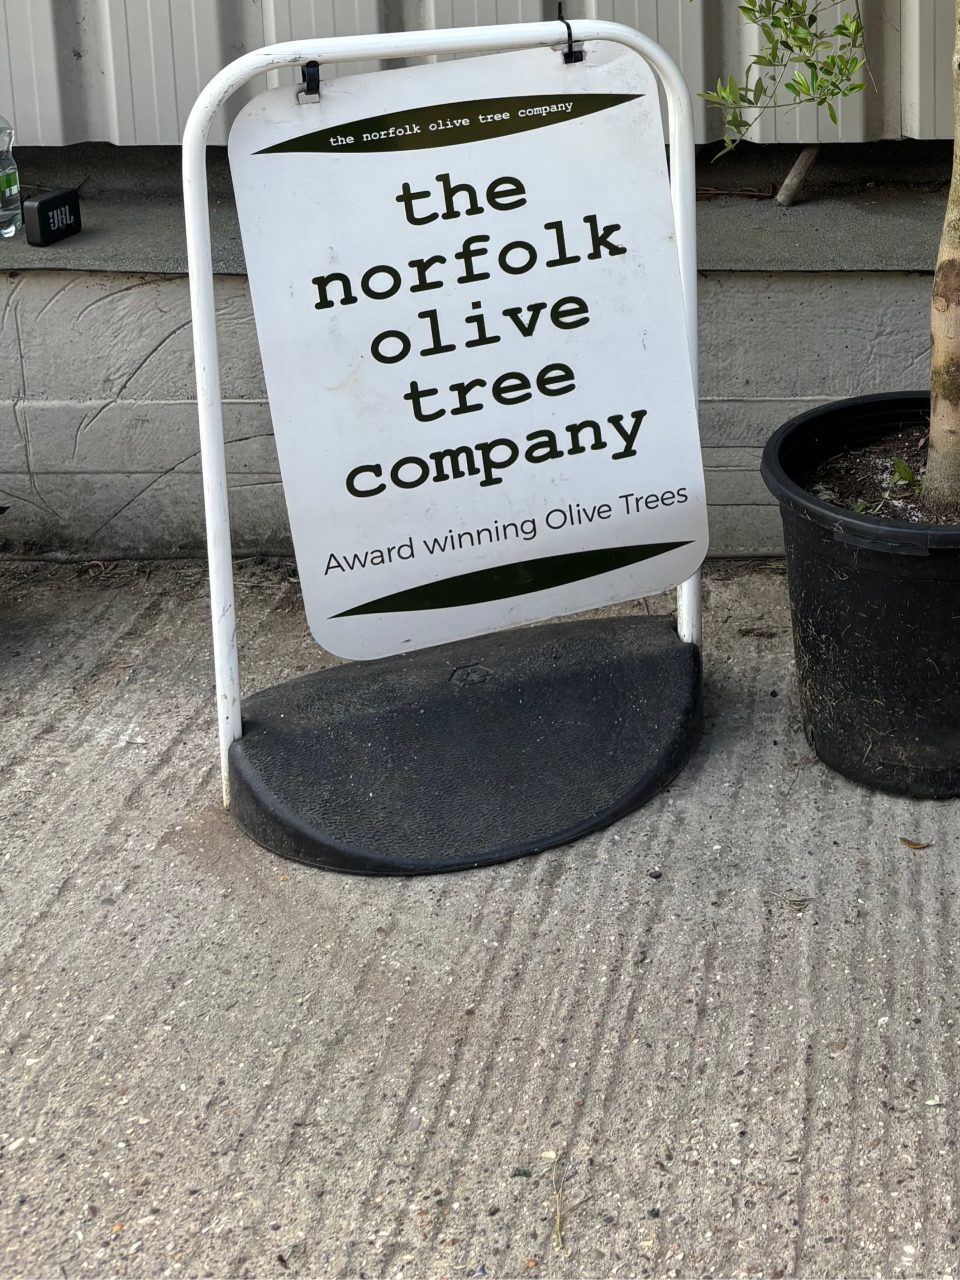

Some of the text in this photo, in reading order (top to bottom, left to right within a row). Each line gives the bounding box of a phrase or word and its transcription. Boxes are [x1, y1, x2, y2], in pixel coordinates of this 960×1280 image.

[329, 101, 574, 147] the norfolk olive tree company
[48, 205, 75, 230] JBL
[396, 172, 527, 226] the
[311, 214, 628, 310] norfolk
[370, 295, 590, 365] olive
[404, 362, 576, 422] tree
[345, 409, 648, 498] company
[324, 486, 690, 576] Award winning Olive Trees
